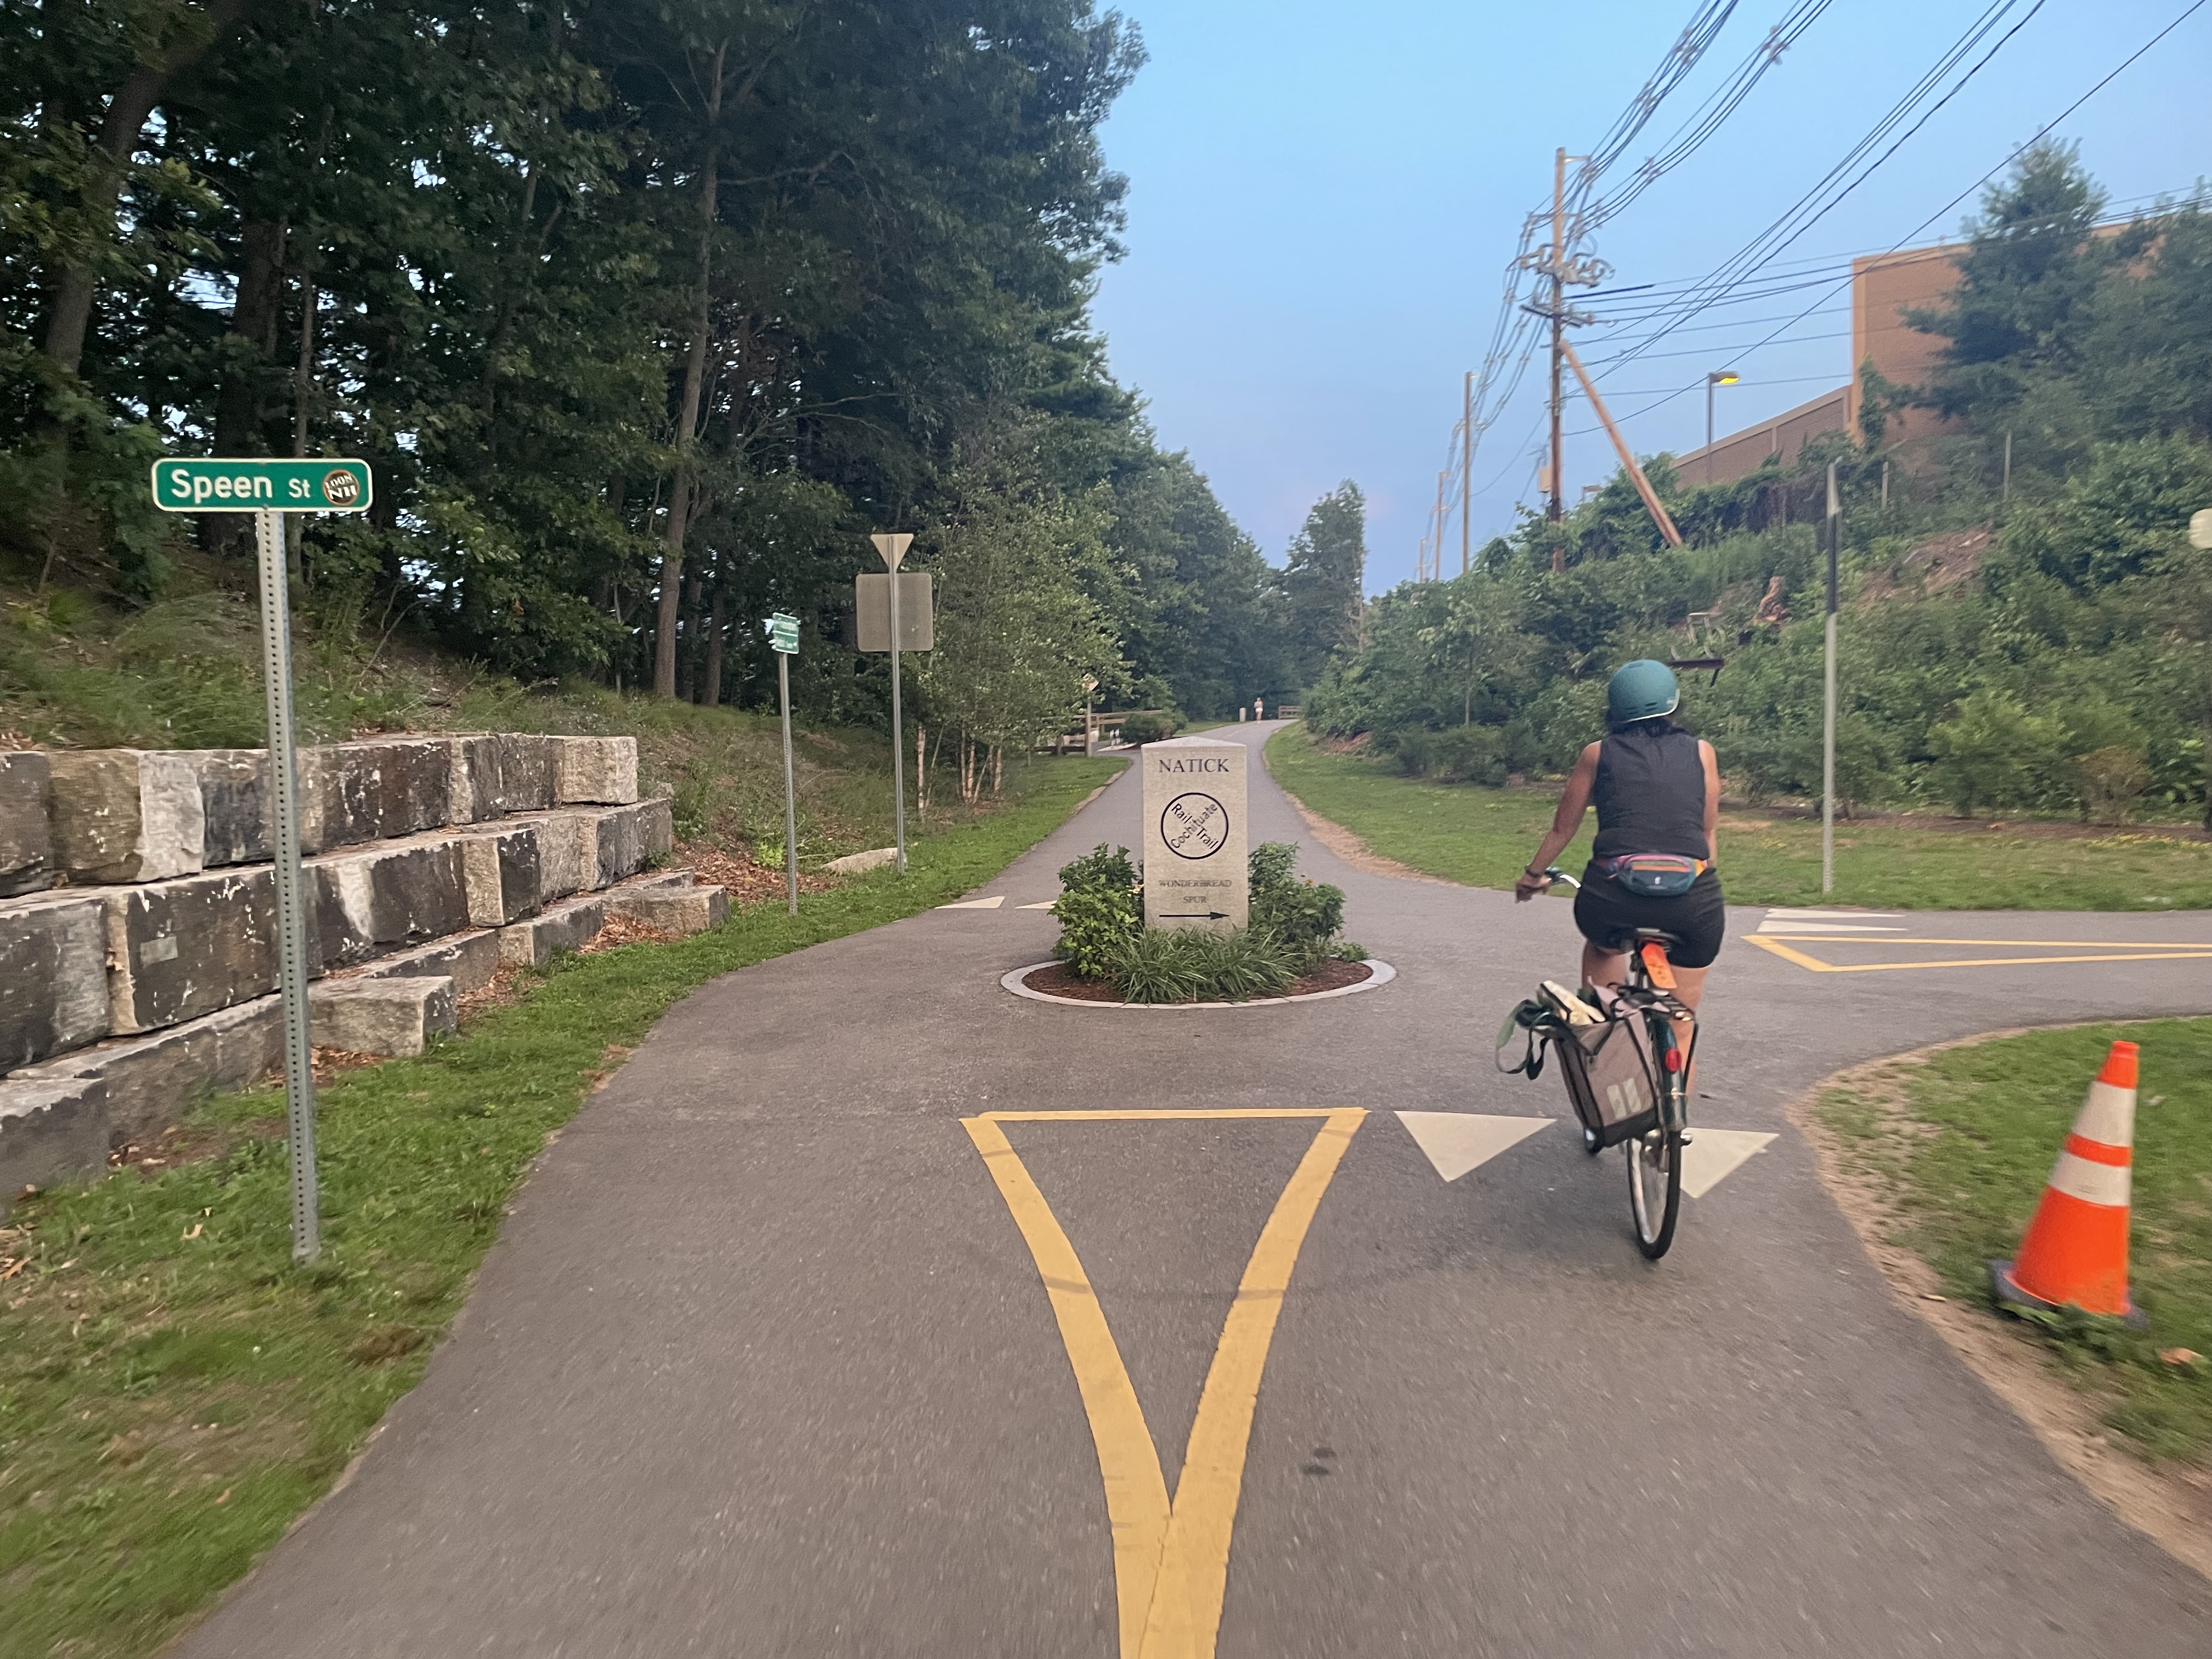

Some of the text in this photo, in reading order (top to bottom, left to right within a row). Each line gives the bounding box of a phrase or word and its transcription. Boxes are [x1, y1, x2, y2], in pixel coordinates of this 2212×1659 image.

[171, 469, 311, 504] Speen St
[1159, 758, 1229, 773] NATICK
[1170, 804, 1218, 848] Cochituate
[1171, 803, 1219, 849] Rail Trail
